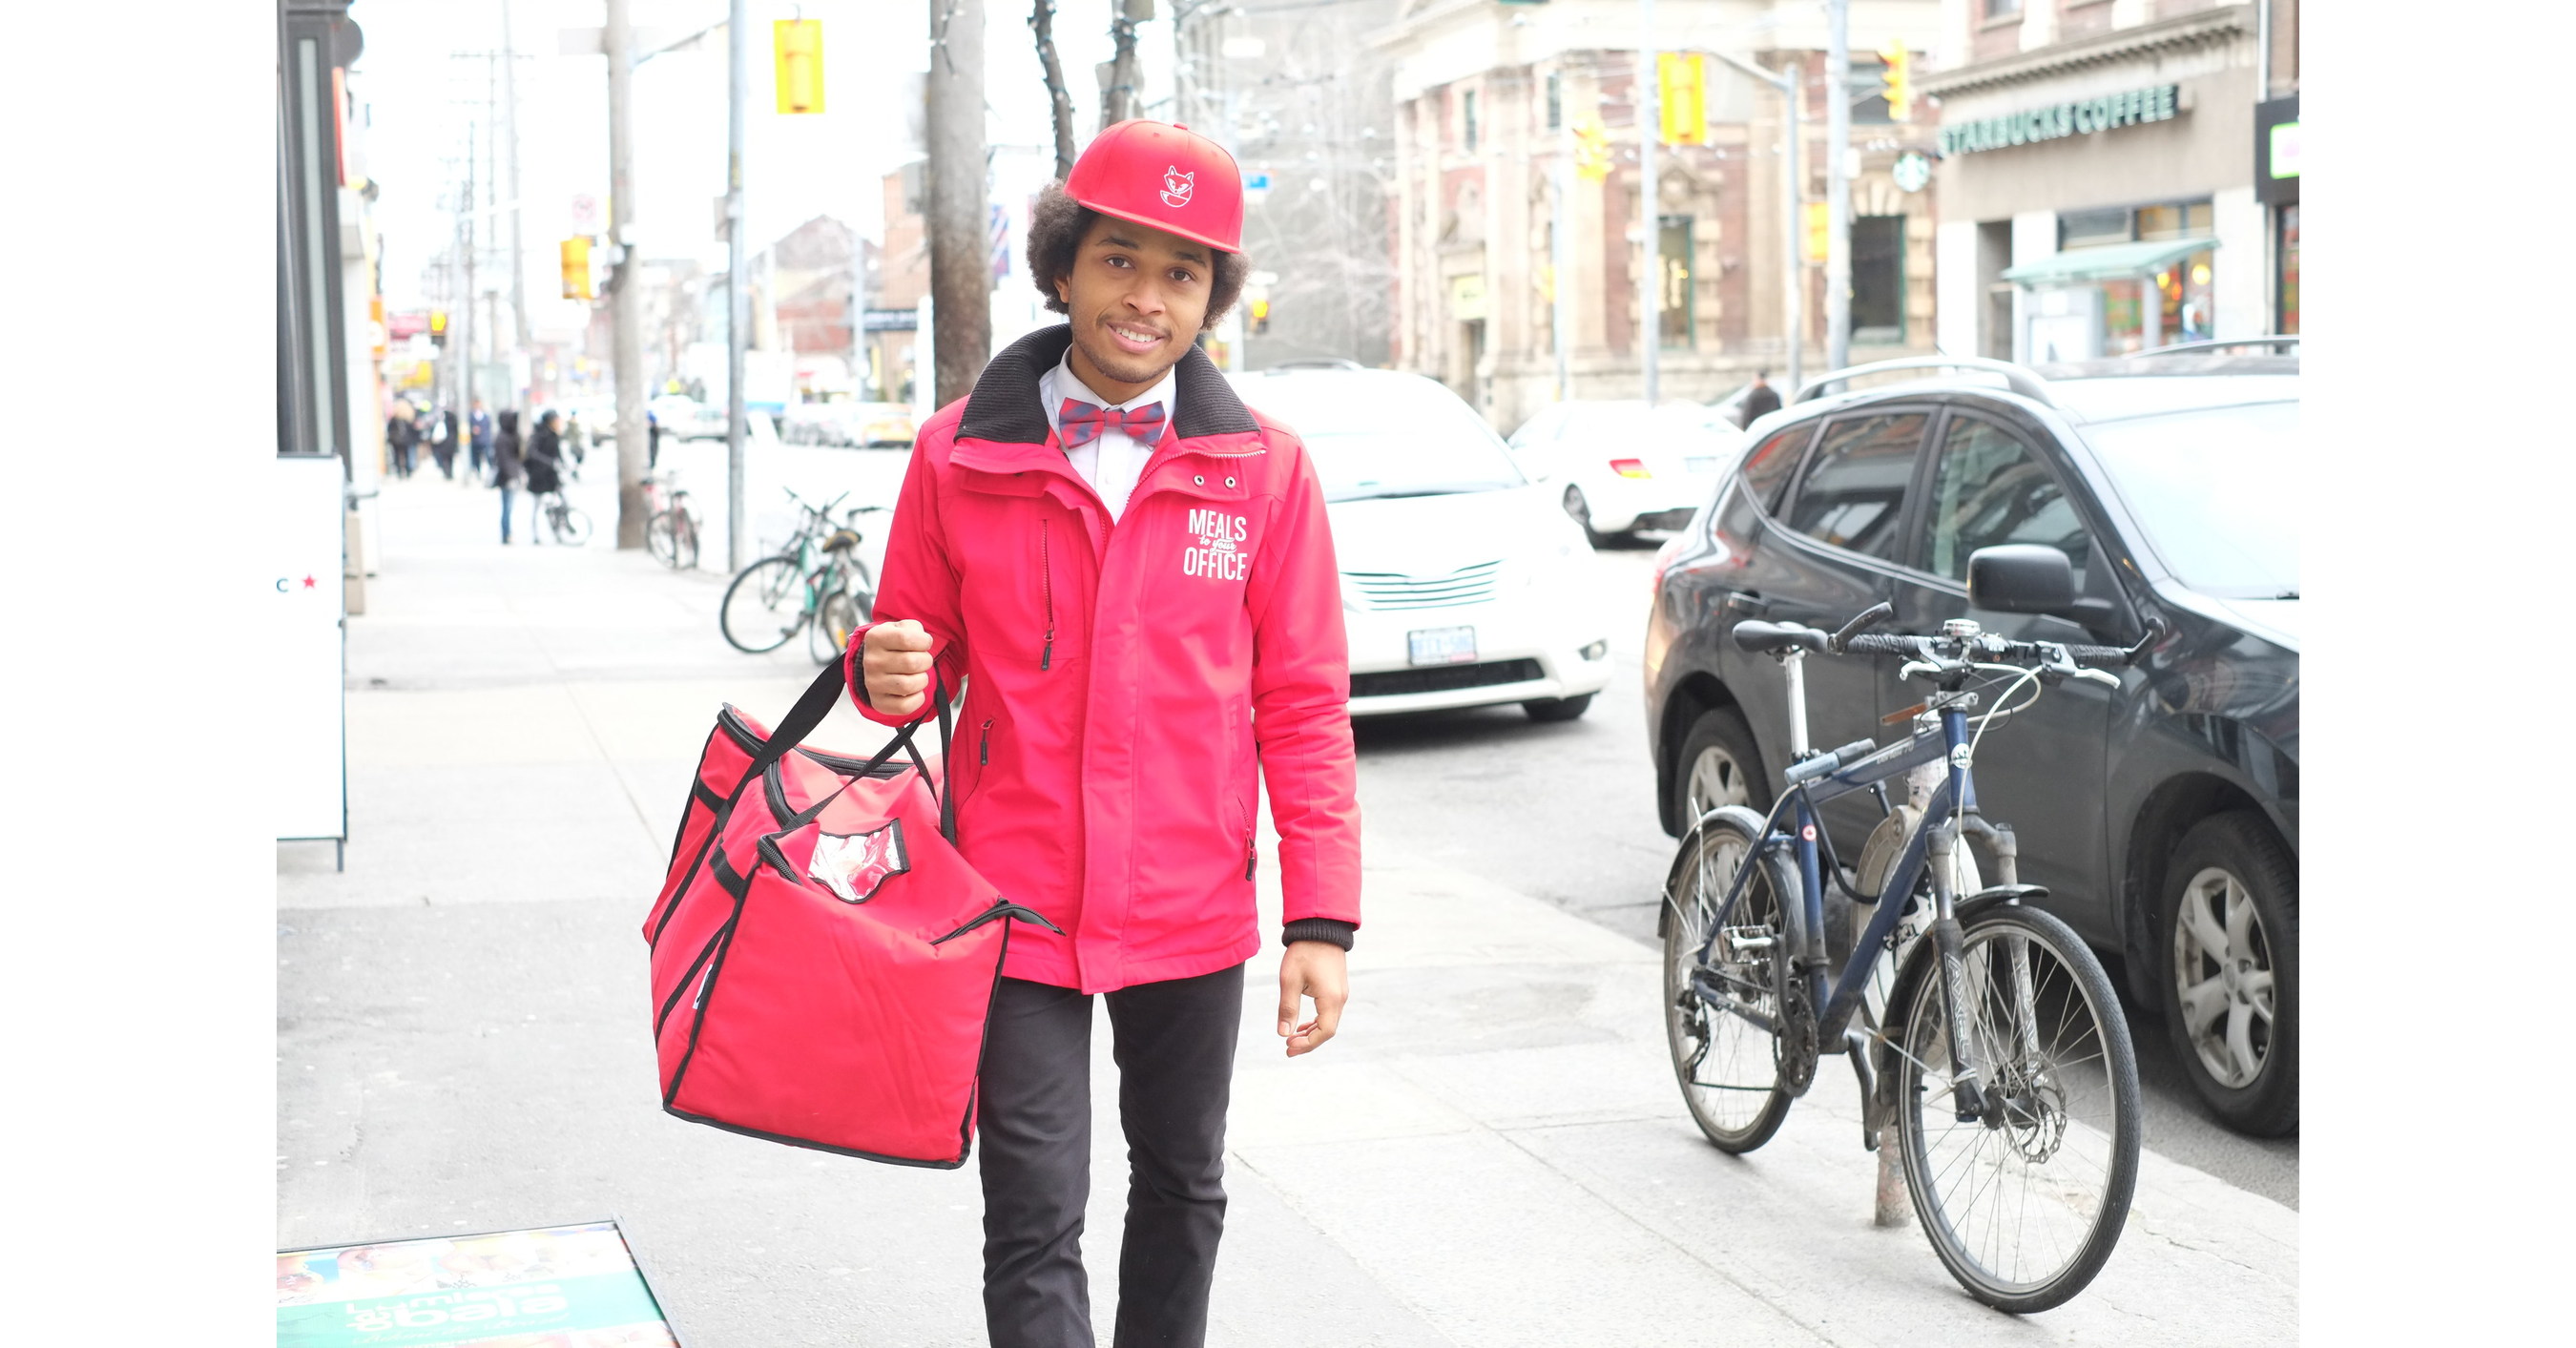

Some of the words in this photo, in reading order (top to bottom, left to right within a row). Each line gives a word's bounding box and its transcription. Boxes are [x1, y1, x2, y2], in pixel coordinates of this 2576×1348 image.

[1936, 103, 2071, 157] STARBUCKS
[2074, 83, 2177, 135] COFFEE
[1188, 508, 1247, 542] MEALS
[1198, 534, 1212, 546] to
[1210, 539, 1237, 553] your
[1183, 547, 1248, 581] OFFICE
